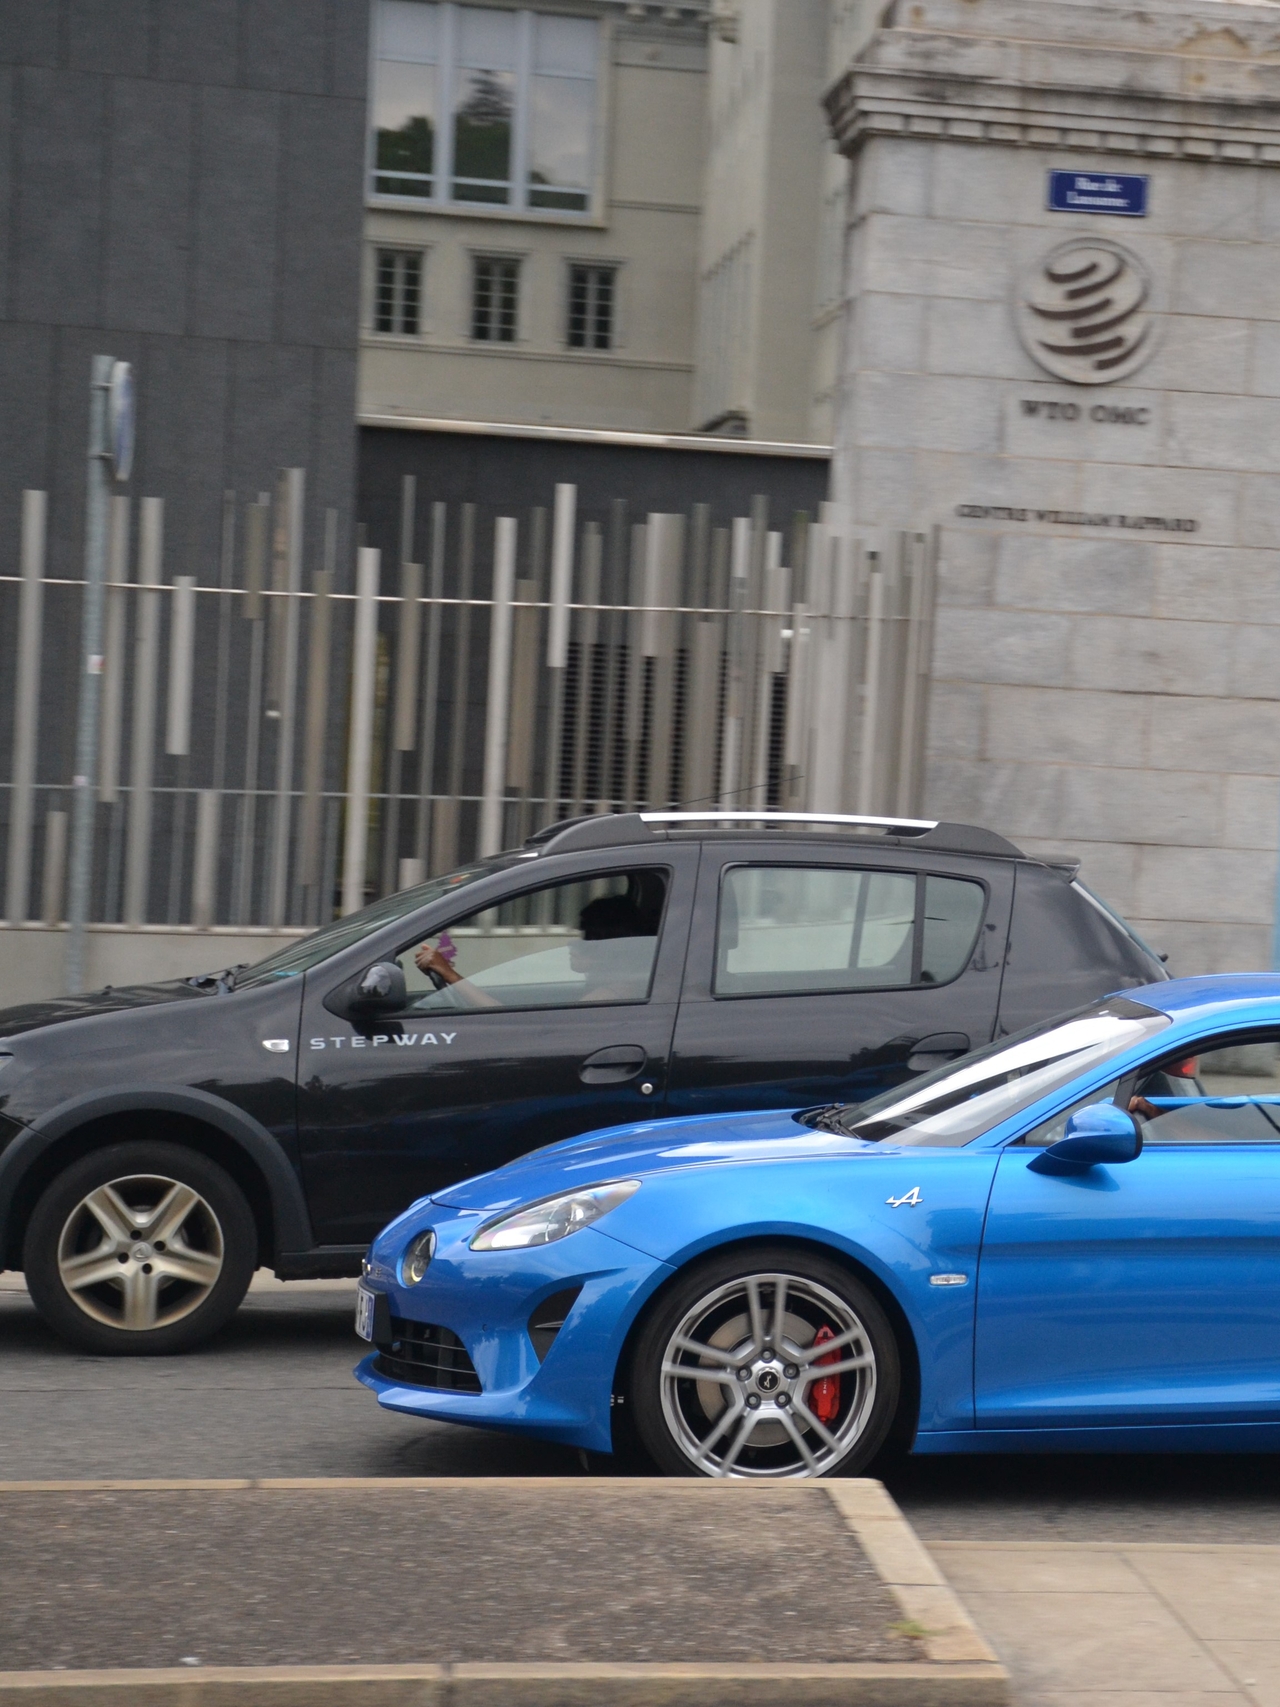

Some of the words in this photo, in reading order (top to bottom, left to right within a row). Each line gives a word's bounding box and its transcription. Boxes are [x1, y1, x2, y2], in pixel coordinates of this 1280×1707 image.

[1019, 400, 1081, 421] WTO
[1090, 404, 1149, 425] OMC
[955, 504, 1029, 522] CENTRE
[1030, 509, 1113, 527] WILLIAM
[1115, 515, 1200, 532] RAPPARD
[310, 1032, 457, 1050] STEPWAY
